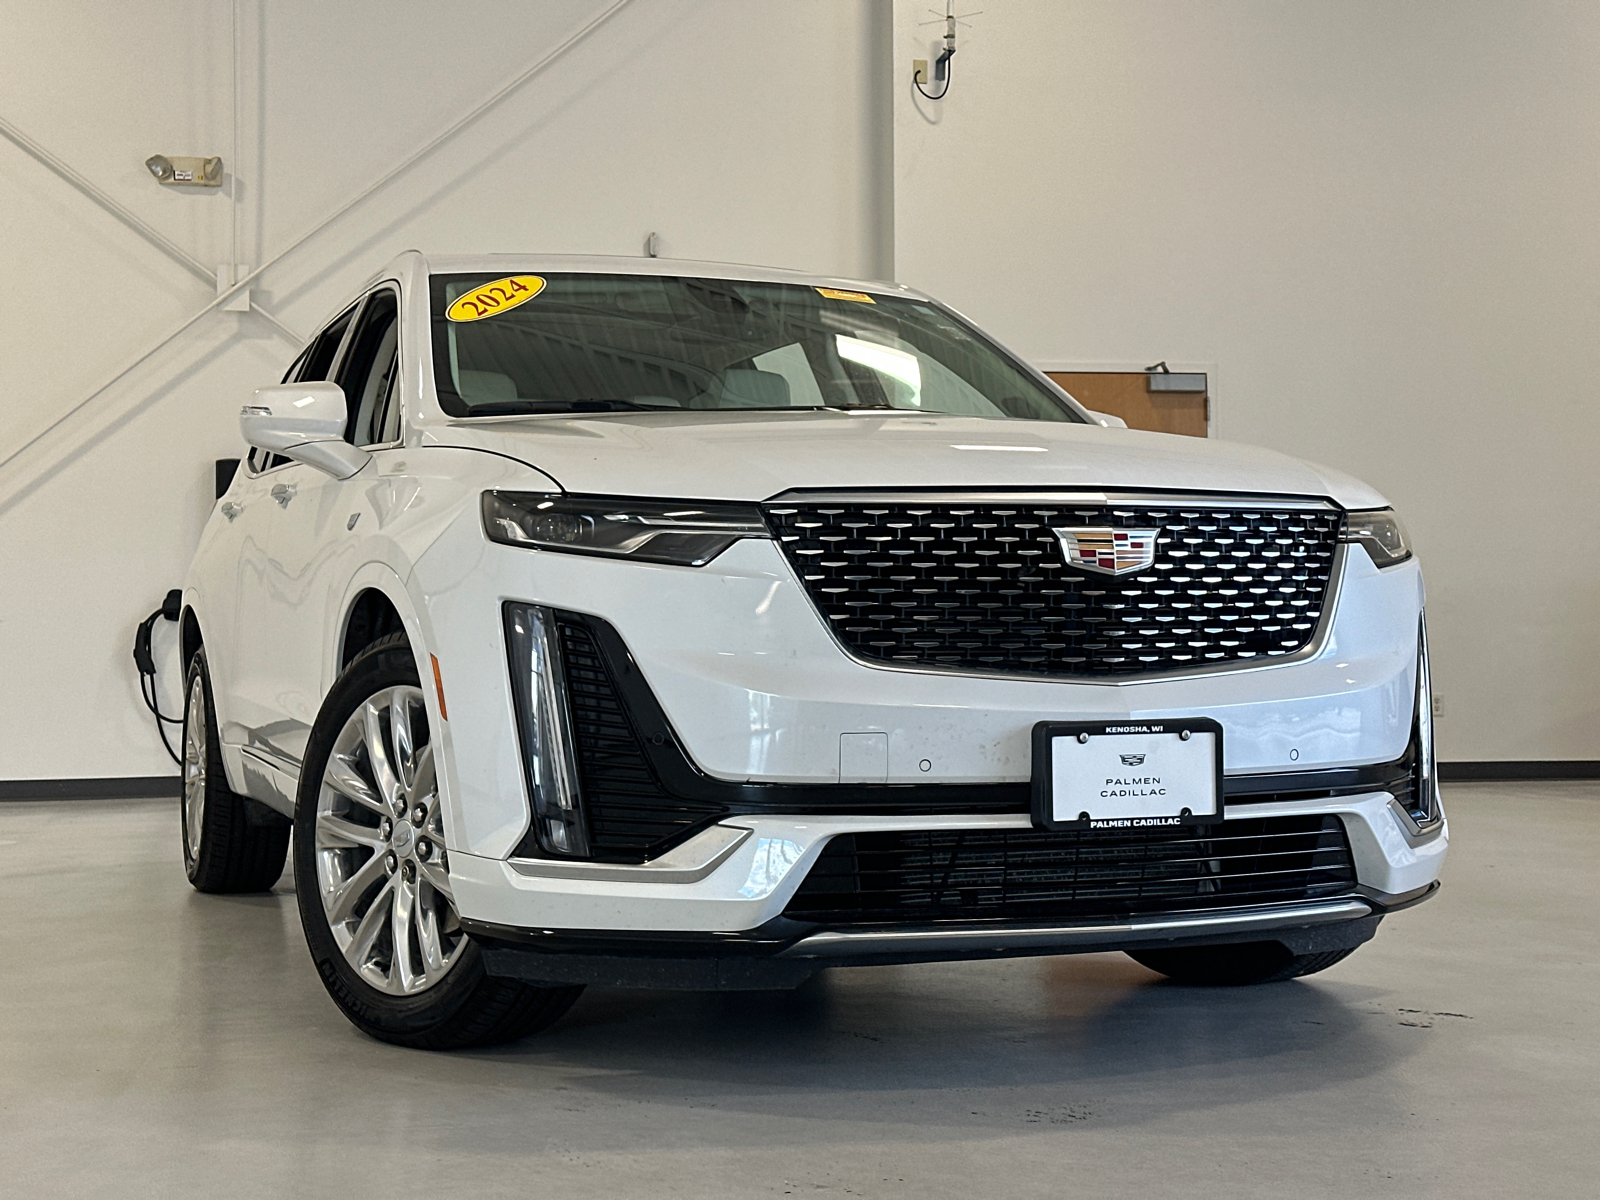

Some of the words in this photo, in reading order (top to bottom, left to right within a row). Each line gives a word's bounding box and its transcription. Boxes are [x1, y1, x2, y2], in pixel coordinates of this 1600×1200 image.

[461, 279, 529, 316] 2024
[1105, 777, 1161, 786] PALMEN
[1100, 788, 1167, 798] CADILLAC
[1090, 820, 1131, 828] PALMEN
[1133, 818, 1181, 826] CADILLAC
